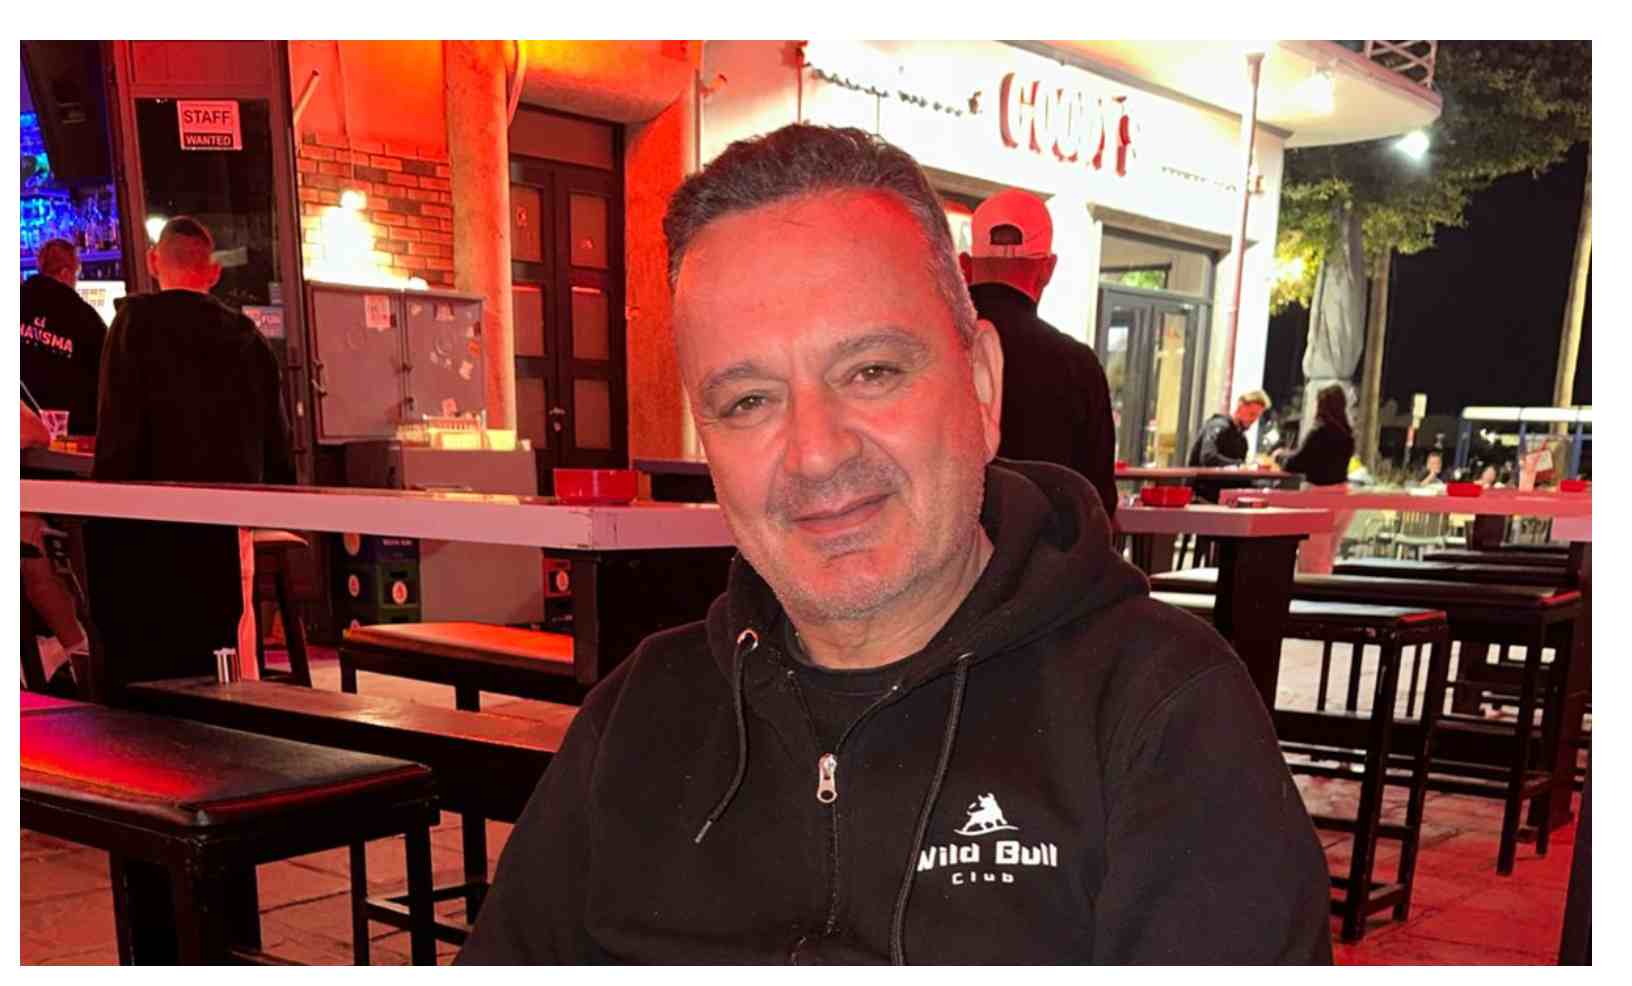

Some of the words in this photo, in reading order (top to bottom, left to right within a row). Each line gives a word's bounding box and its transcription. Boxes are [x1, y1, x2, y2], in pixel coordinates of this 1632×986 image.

[183, 109, 232, 126] STAFF
[186, 134, 232, 147] WANTED
[995, 840, 1058, 867] Bull
[951, 871, 1014, 885] Club
